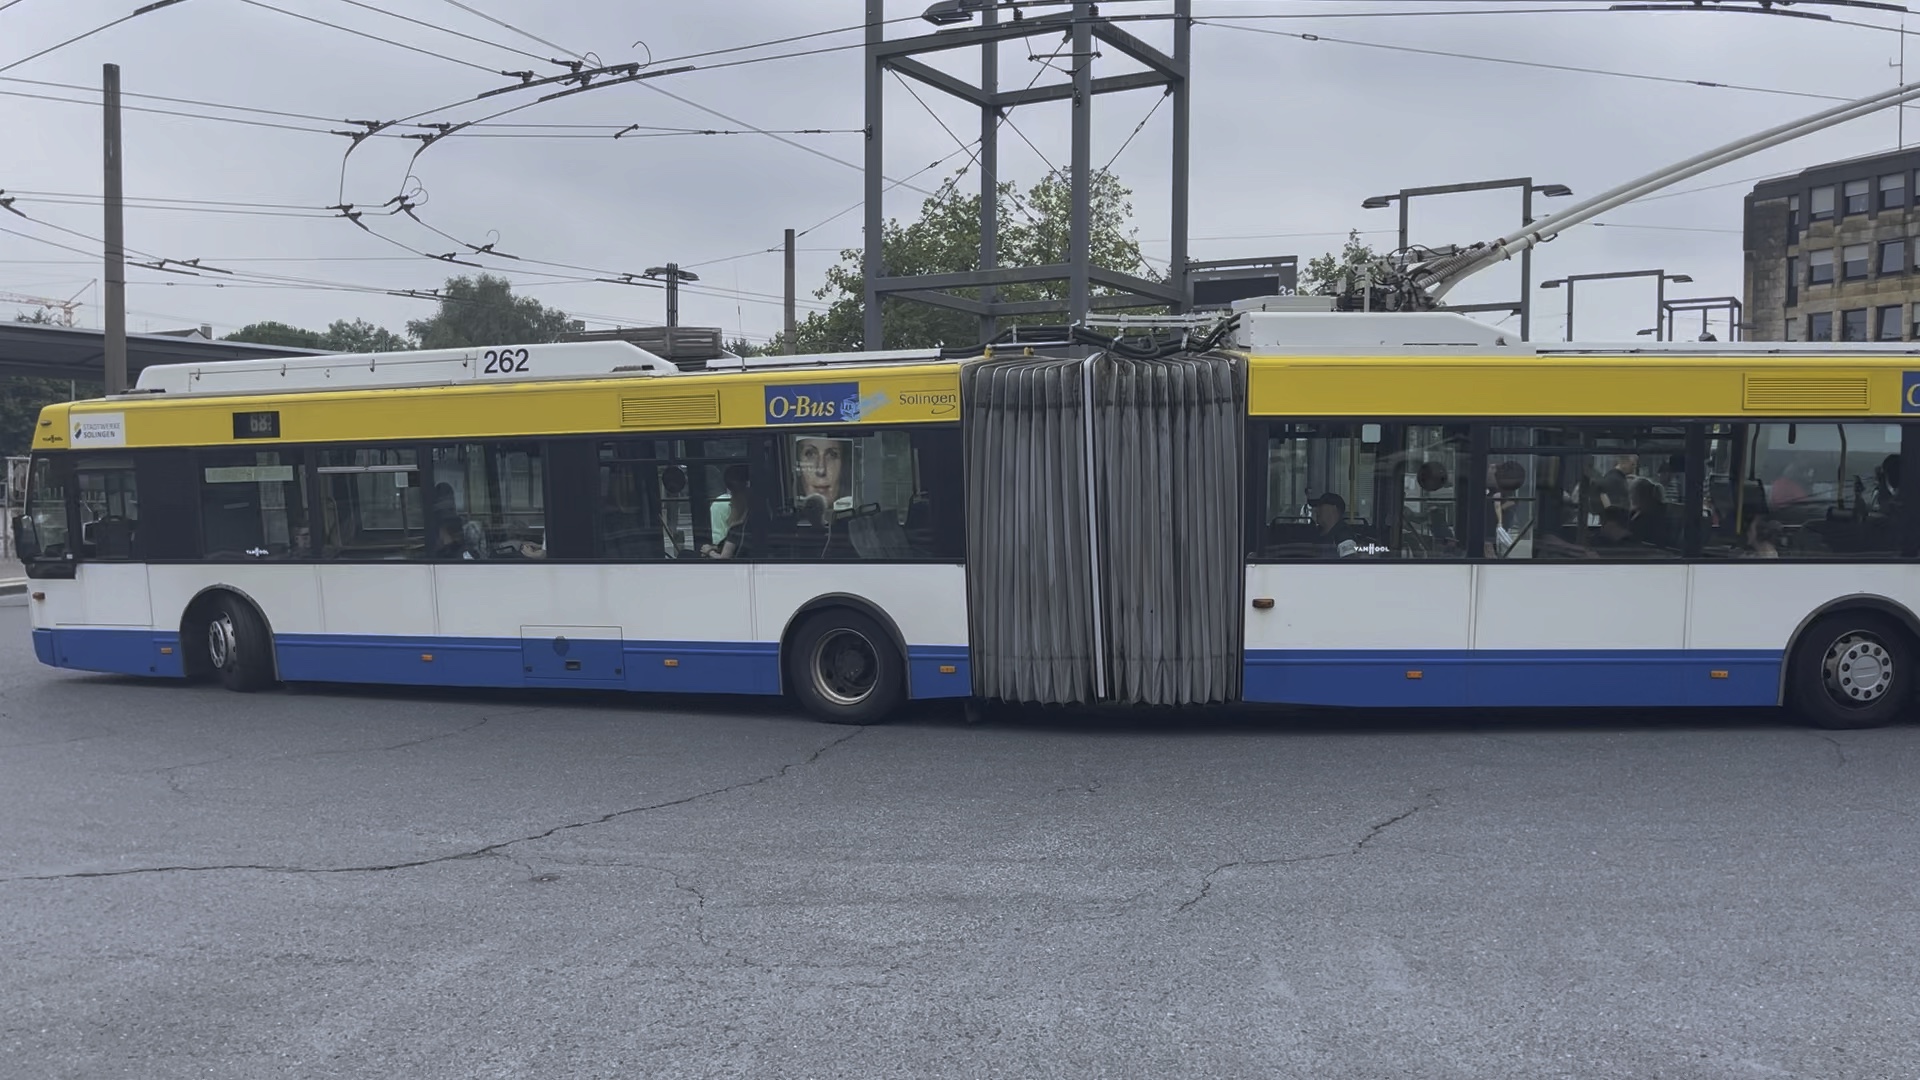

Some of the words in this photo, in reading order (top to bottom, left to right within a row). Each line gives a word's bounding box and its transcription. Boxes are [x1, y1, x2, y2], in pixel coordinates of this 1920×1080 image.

[484, 348, 529, 374] 262
[769, 394, 836, 419] O-Bus
[899, 393, 956, 415] Solingen
[83, 423, 120, 431] STADTWERKE
